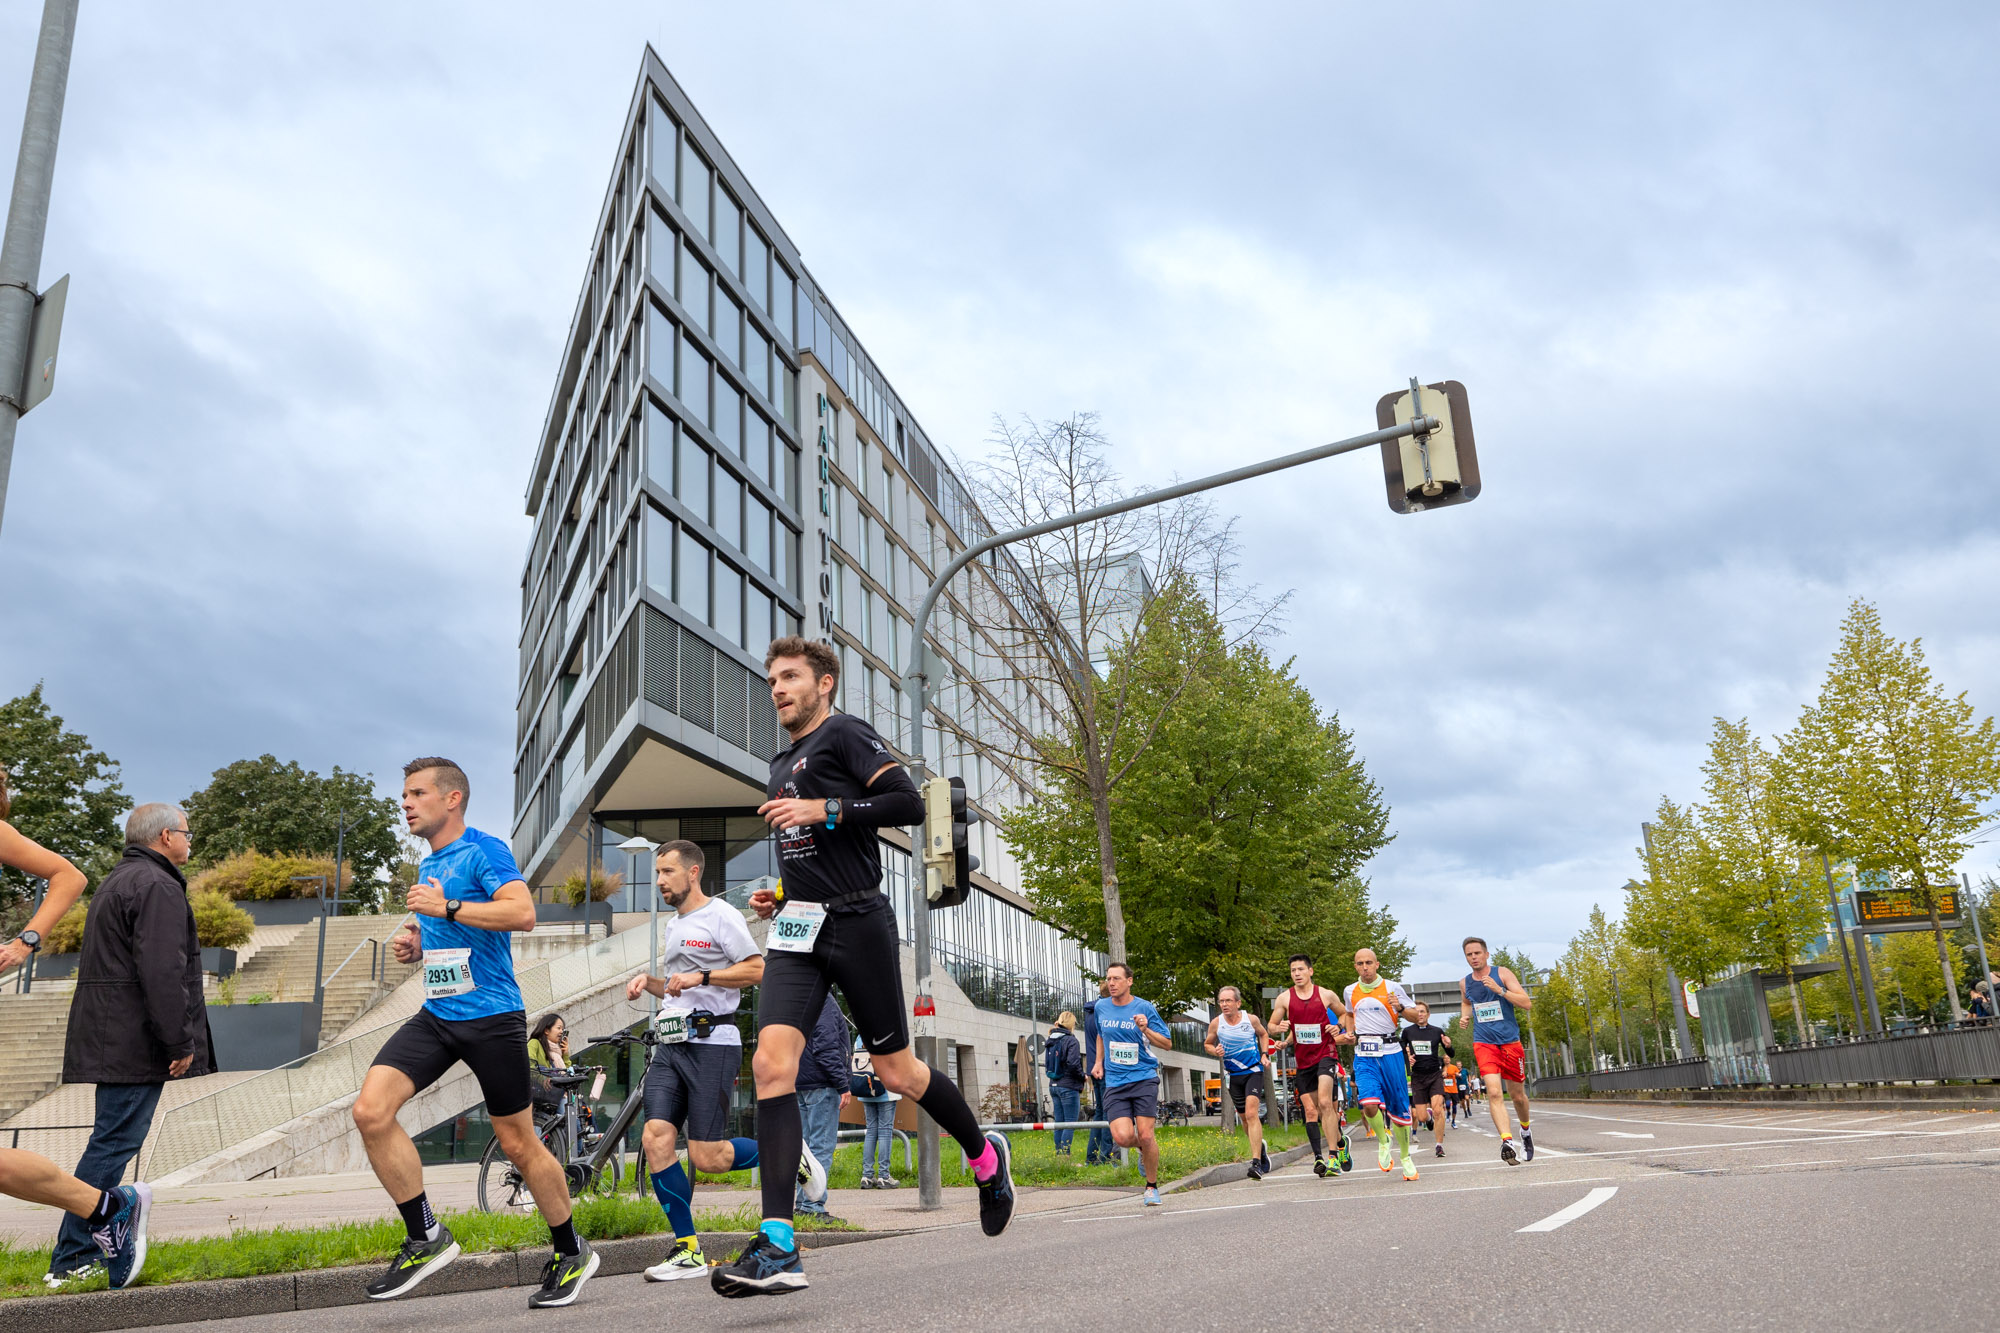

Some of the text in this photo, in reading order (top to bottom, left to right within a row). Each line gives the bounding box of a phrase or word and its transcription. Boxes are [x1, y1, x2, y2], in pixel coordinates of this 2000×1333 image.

[817, 392, 833, 647] PARK TOW
[778, 921, 810, 938] 3826
[686, 939, 711, 949] KOCH
[428, 967, 456, 984] 2931
[431, 987, 457, 996] Matthias
[1479, 1009, 1496, 1017] 3977
[1101, 1019, 1136, 1030] TEAM BGV
[1363, 1043, 1376, 1051] 716
[1115, 1050, 1133, 1059] 4155
